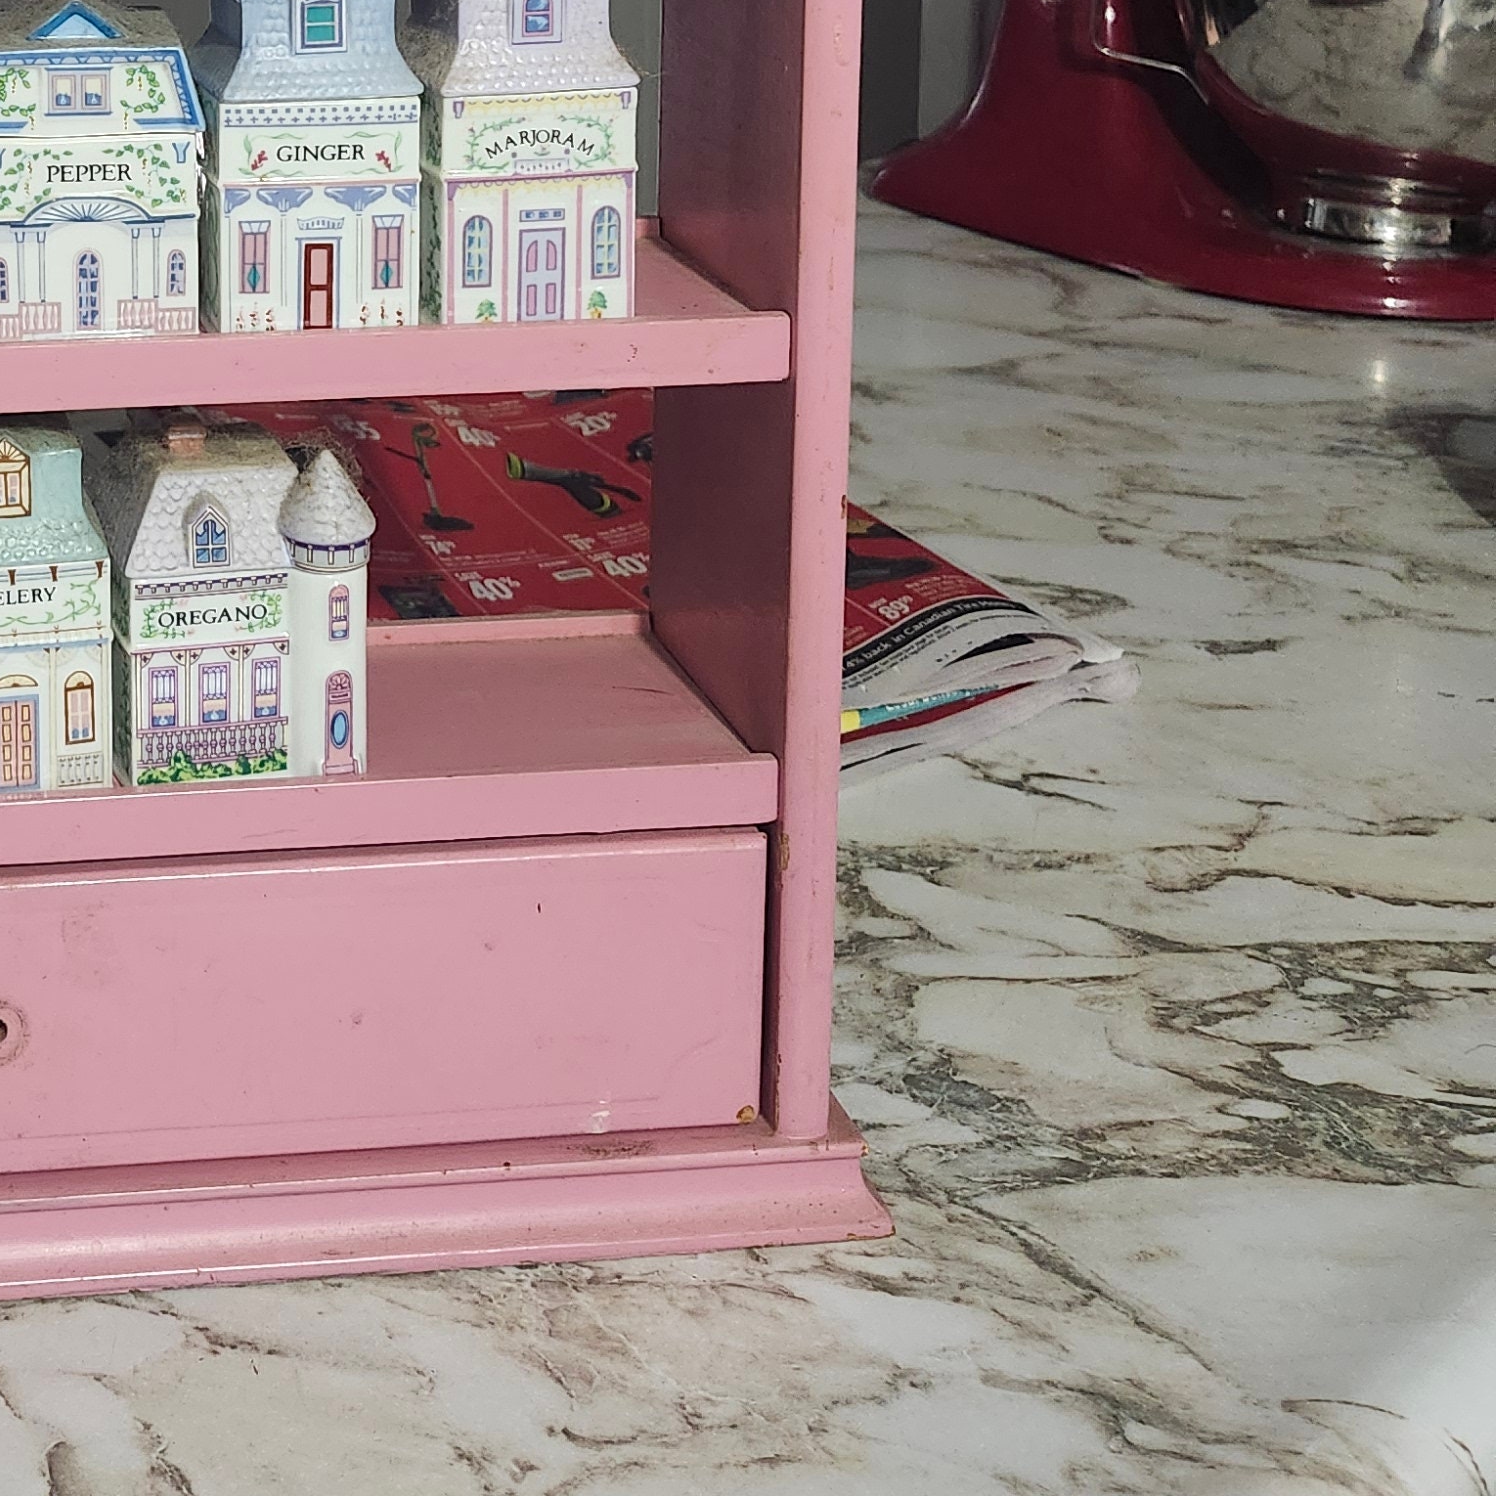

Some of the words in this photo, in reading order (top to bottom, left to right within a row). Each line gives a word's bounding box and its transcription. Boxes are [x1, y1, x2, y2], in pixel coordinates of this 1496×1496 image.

[275, 143, 366, 163] GINGER
[484, 128, 596, 160] MARJORAM
[45, 163, 133, 184] PEPPER
[157, 603, 268, 629] OREGANO
[904, 607, 956, 636] Canadian
